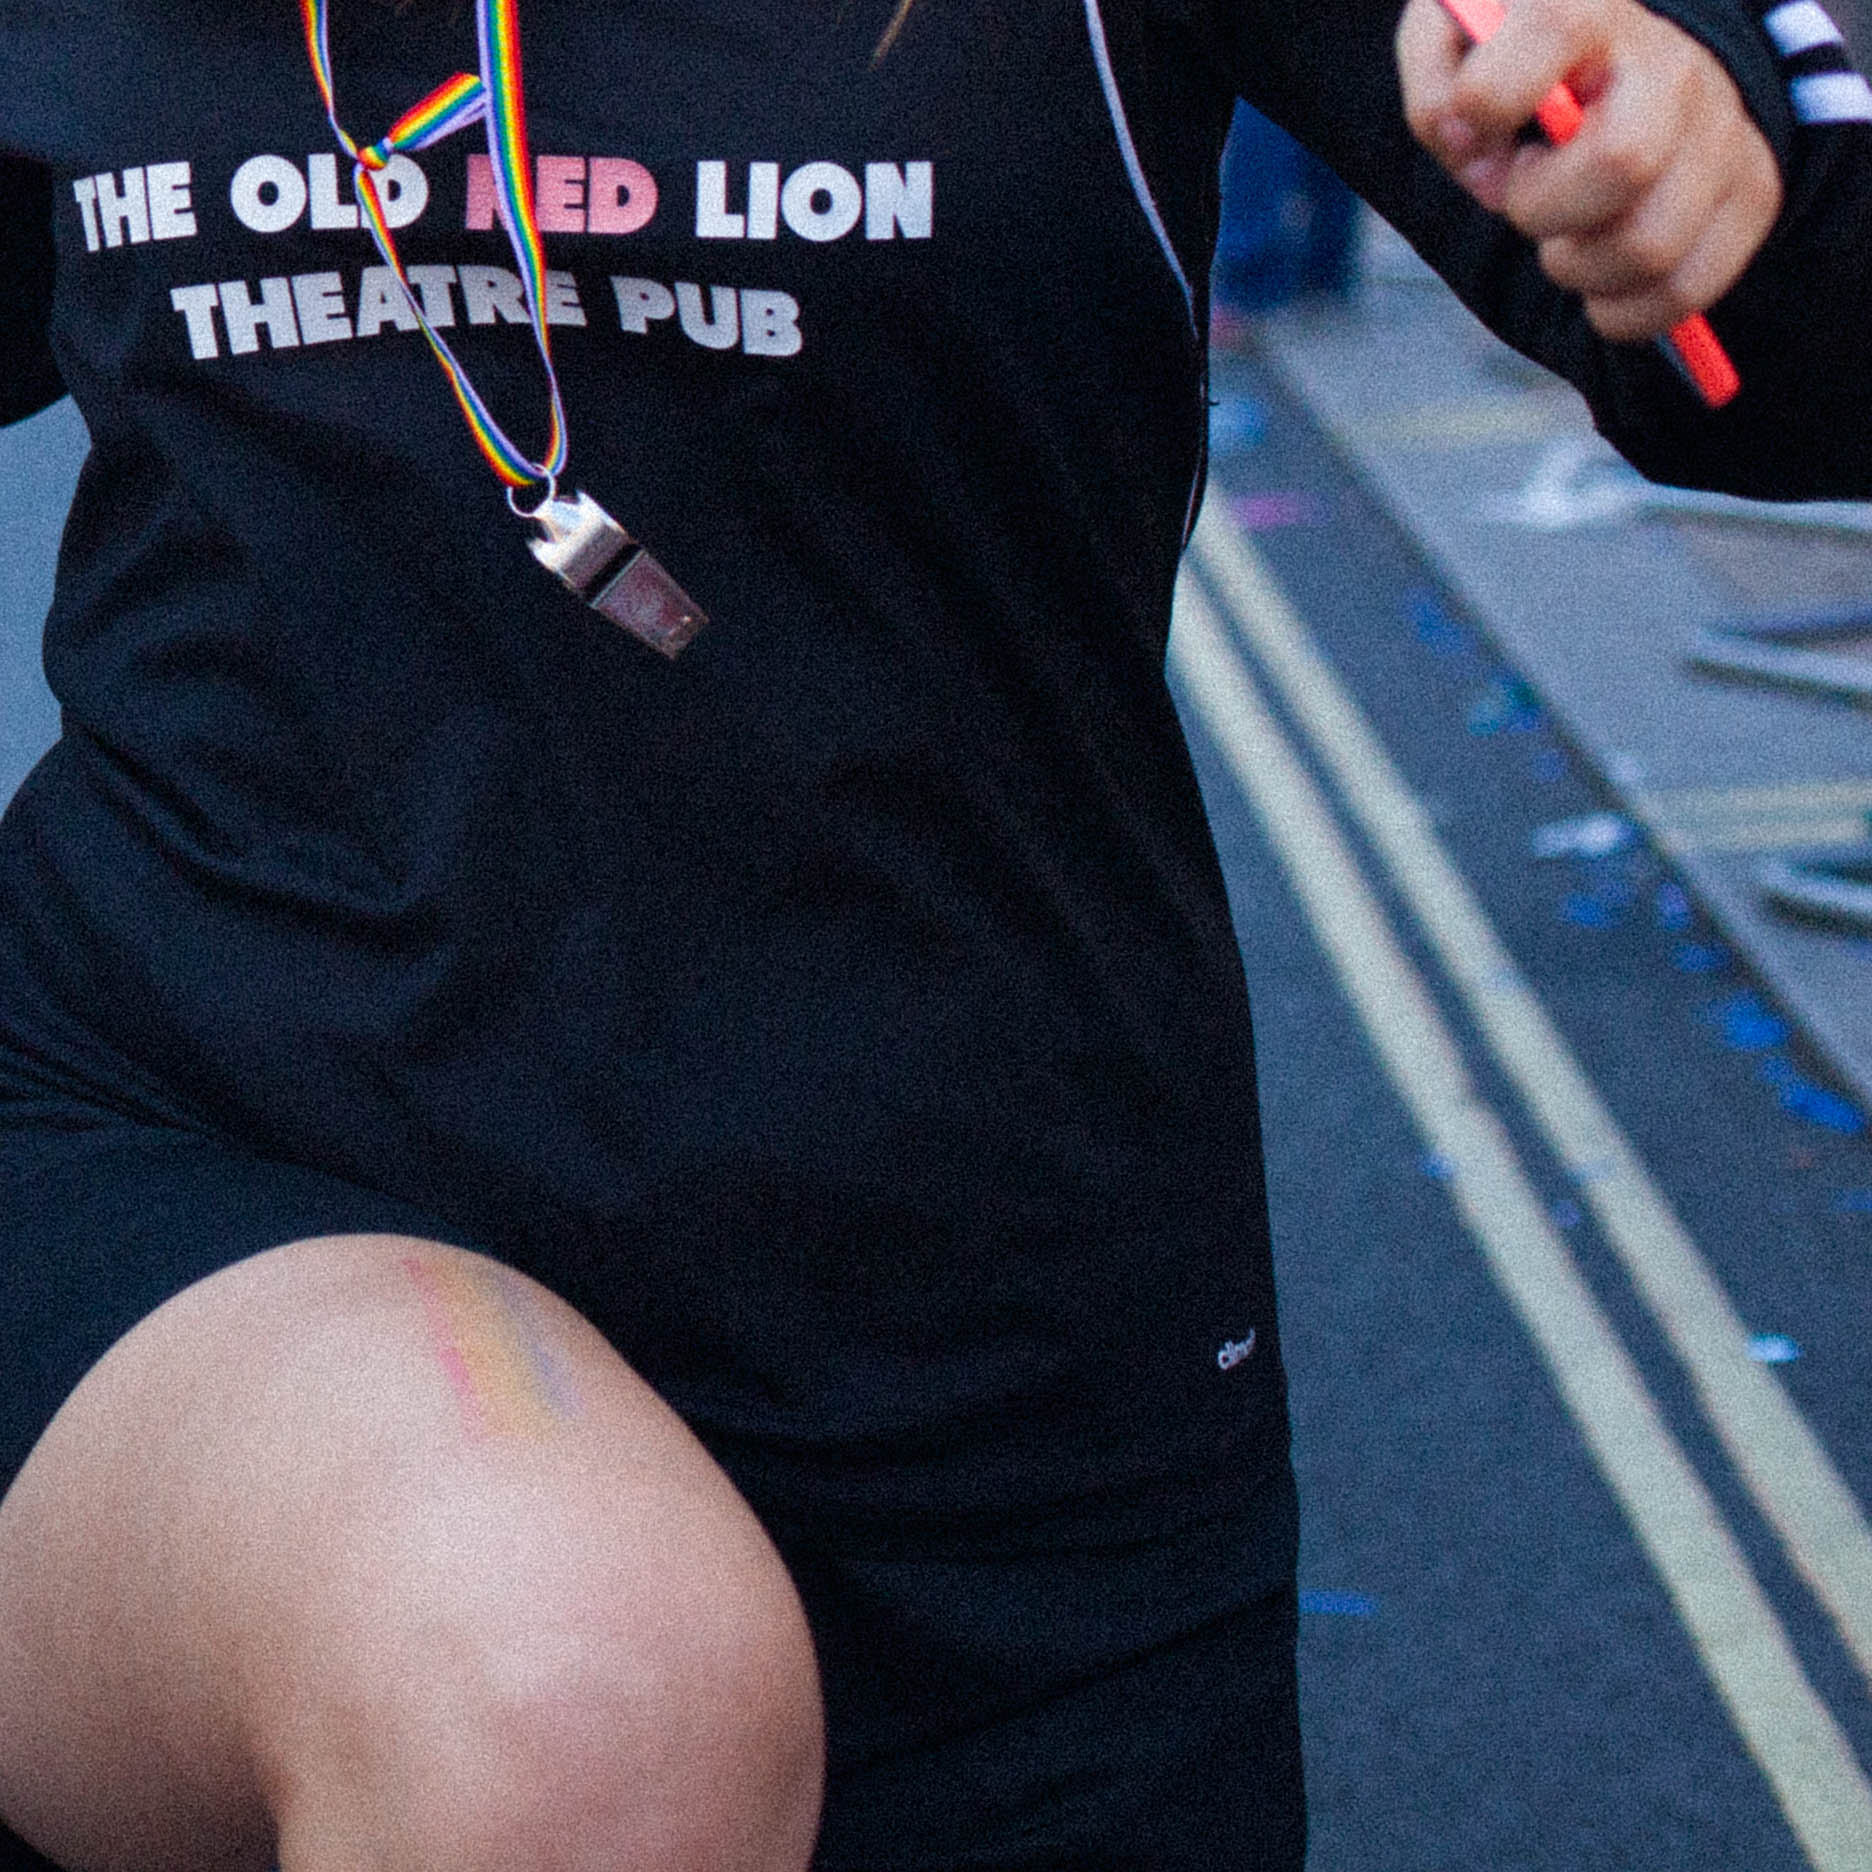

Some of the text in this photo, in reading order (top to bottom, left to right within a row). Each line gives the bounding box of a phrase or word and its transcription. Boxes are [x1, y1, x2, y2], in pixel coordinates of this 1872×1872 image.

[72, 153, 933, 252] THE OLD RED LION
[170, 264, 804, 360] THEATRE PUB
